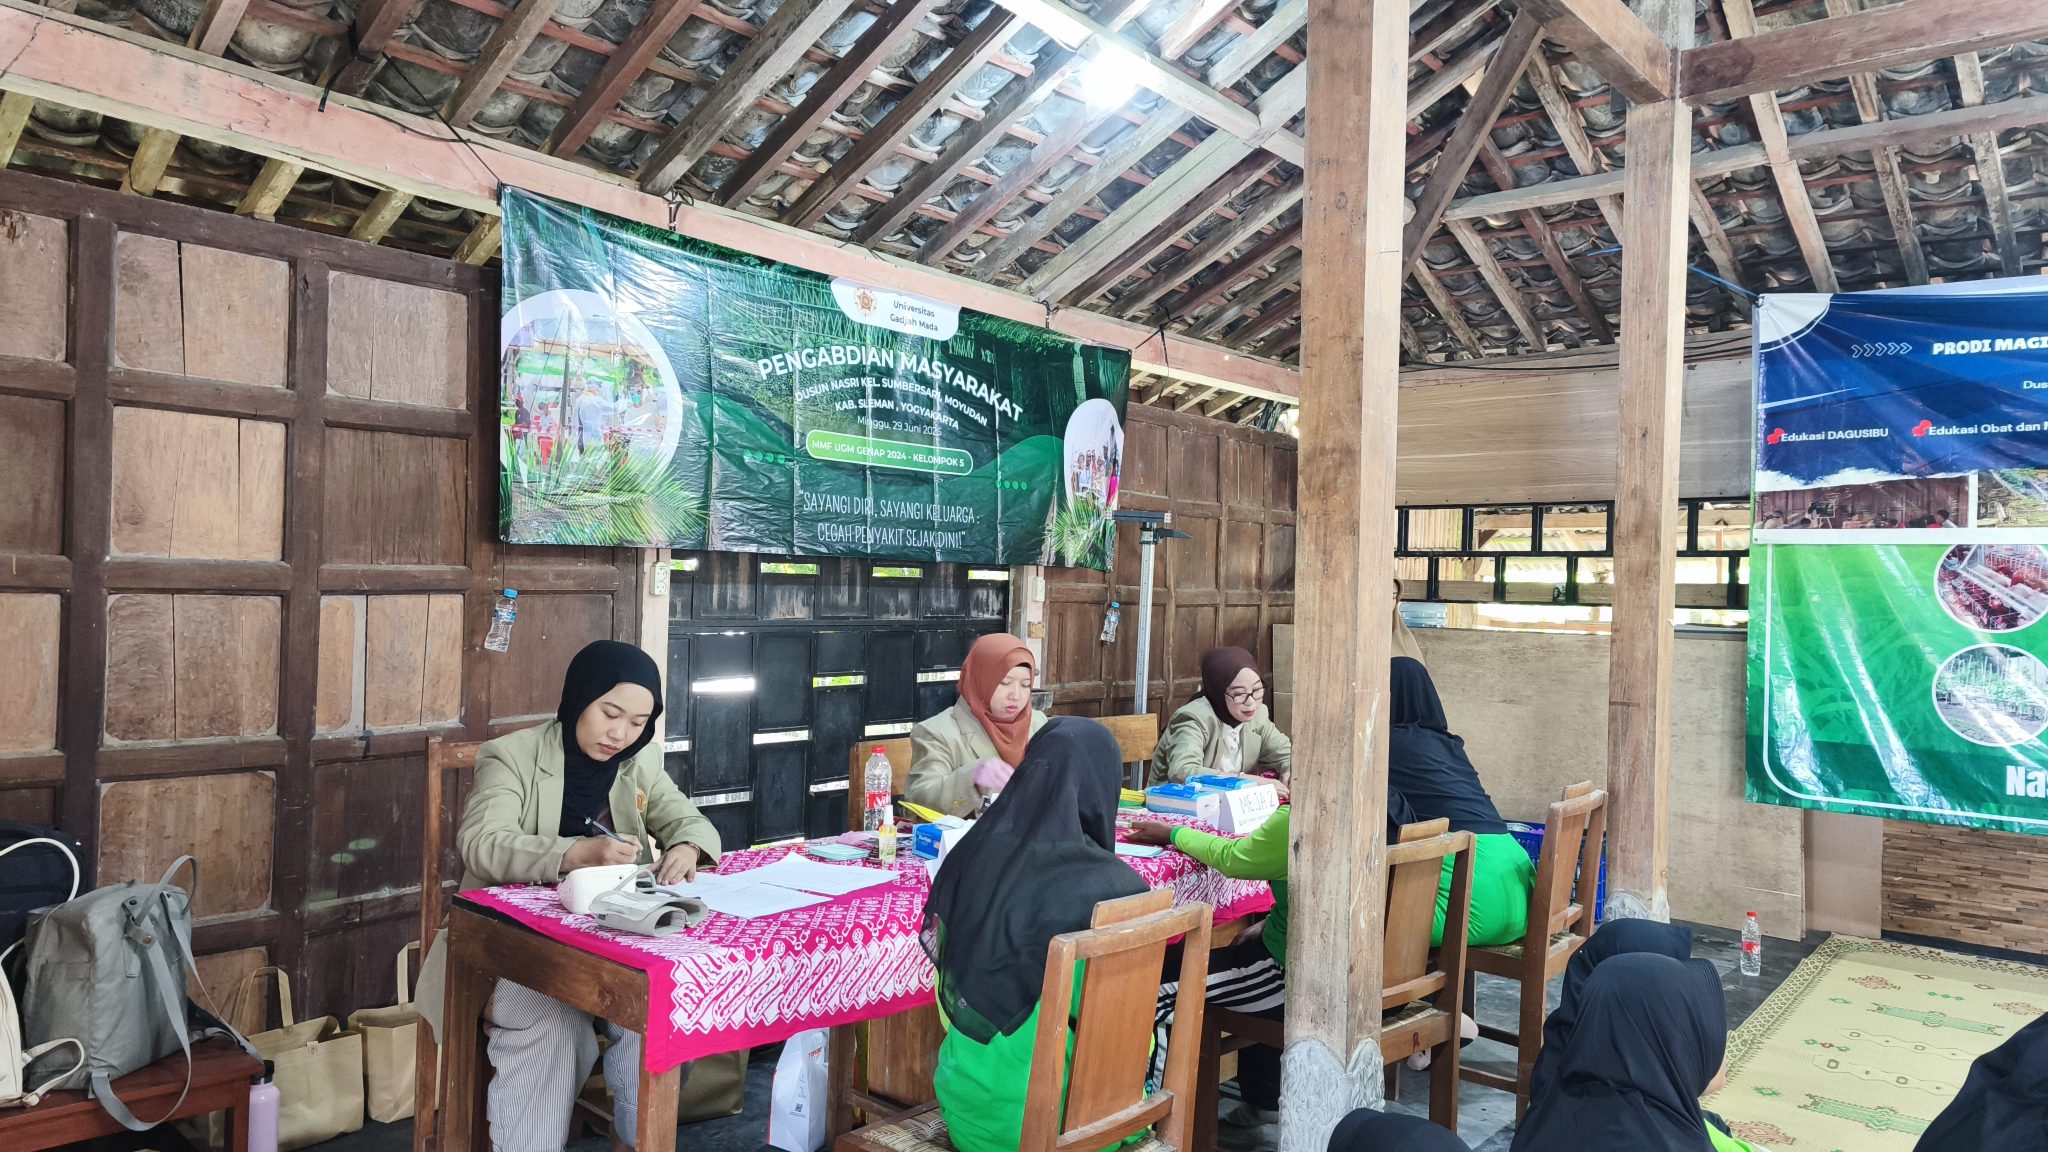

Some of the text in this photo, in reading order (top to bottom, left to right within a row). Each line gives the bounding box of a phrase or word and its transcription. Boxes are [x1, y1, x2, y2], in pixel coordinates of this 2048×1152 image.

[893, 300, 935, 317] Universitas
[889, 313, 938, 331] Gadjah Mada
[1932, 339, 1991, 355] PRODI
[757, 345, 1023, 422] PENGABDIAN MASYARAKAT
[795, 382, 829, 401] DUSUN
[830, 378, 859, 390] NASRI
[861, 377, 880, 388] KEL.
[944, 394, 988, 427] MOYUDAN
[835, 400, 857, 411] KAB.
[858, 399, 894, 410] SLEMAN
[900, 402, 959, 430] YOGYAKARTA
[892, 421, 903, 431] 29
[903, 421, 922, 433] Juni
[1781, 428, 1889, 442] Edukasi DAGUSIBU
[1928, 424, 1978, 436] Edukasi
[1980, 423, 2013, 434] Obat
[2016, 422, 2040, 432] dan
[812, 440, 833, 451] MMF
[834, 443, 855, 454] UGM
[856, 446, 885, 458] GENAP
[887, 449, 907, 460] 2024
[913, 453, 958, 467] KELOMPOK
[958, 458, 965, 467] 5
[880, 499, 924, 520] SAYANGI
[926, 504, 975, 524] KELUARGA
[817, 522, 851, 542] CEGAH
[855, 525, 903, 546] PENYAKIT
[906, 530, 936, 548] SEJAK
[2006, 765, 2048, 798] Na
[1238, 790, 1276, 815] MEJA 2
